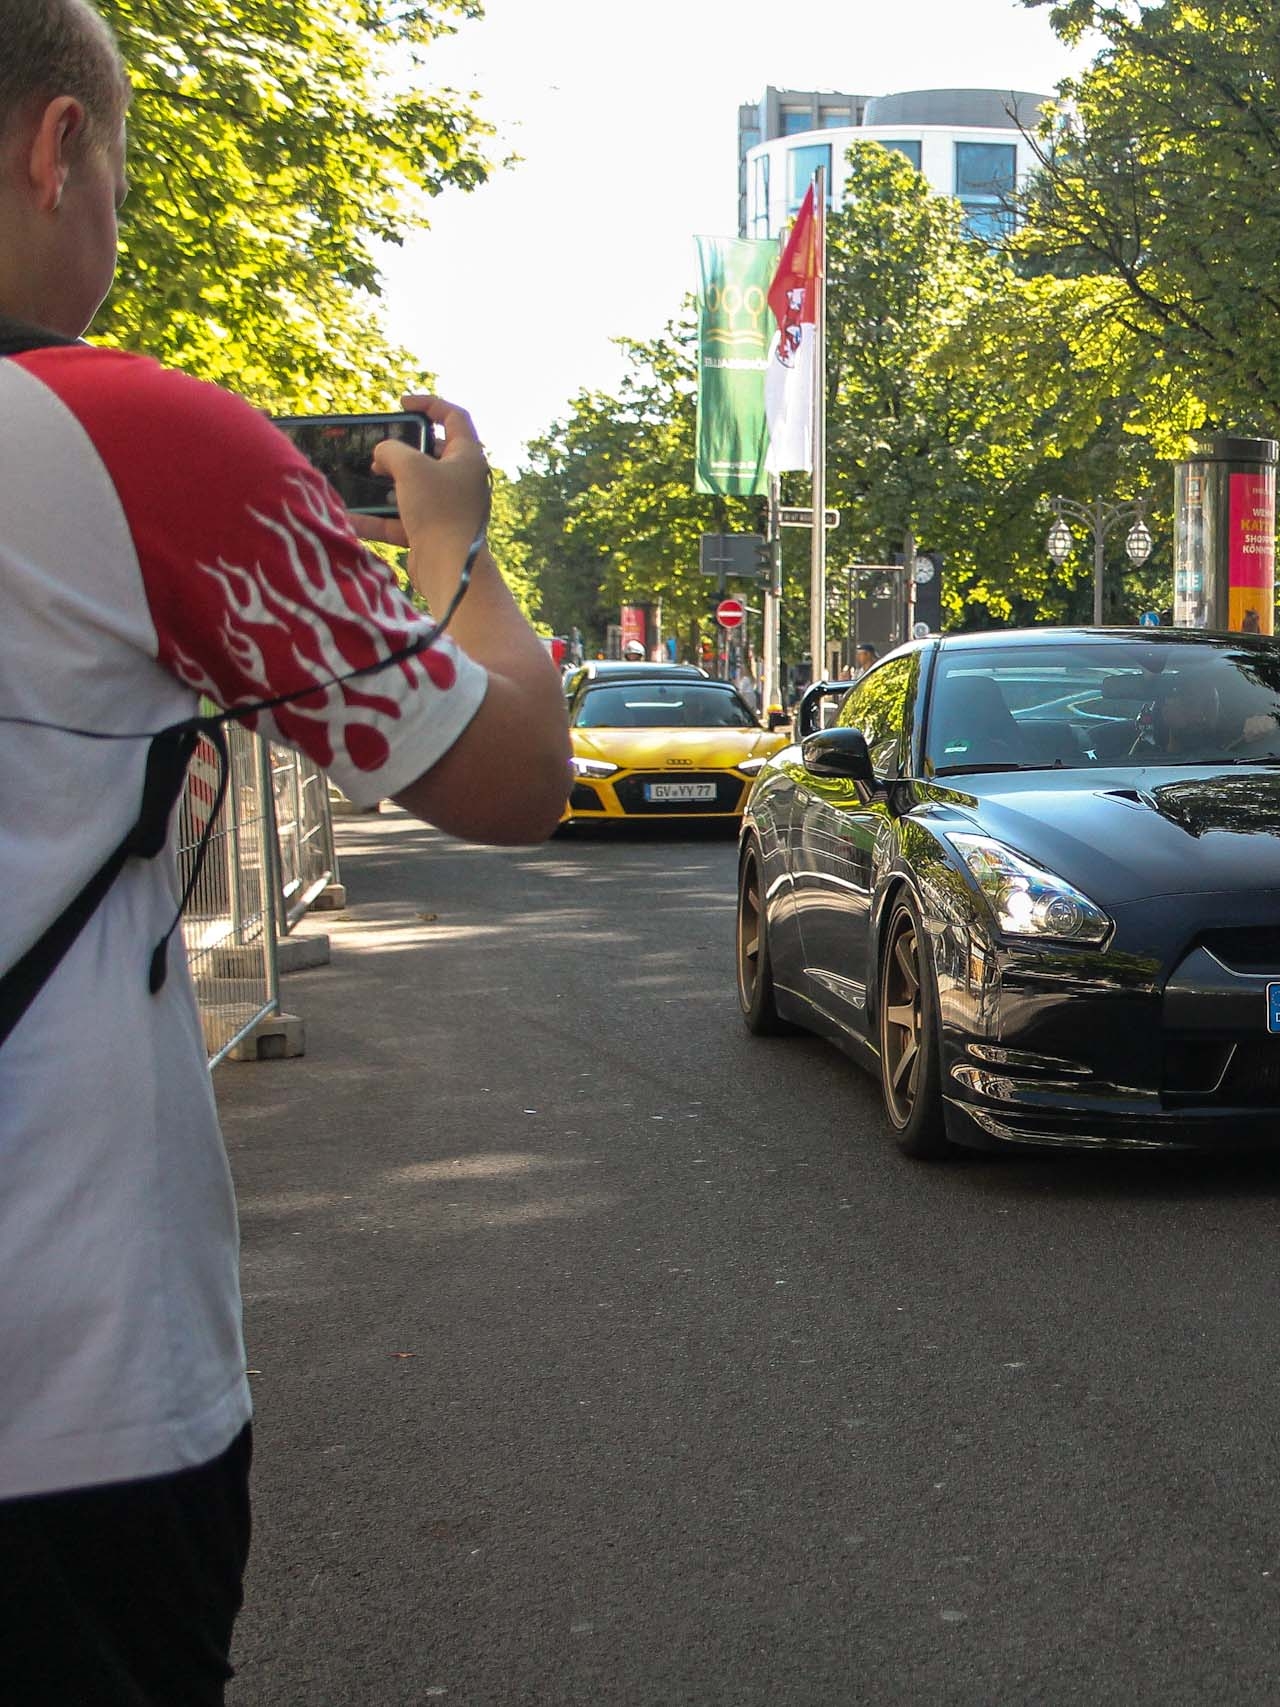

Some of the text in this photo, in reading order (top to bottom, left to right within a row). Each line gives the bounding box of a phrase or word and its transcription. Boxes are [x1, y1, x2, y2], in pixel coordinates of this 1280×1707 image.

[655, 785, 711, 797] GV YY 77
